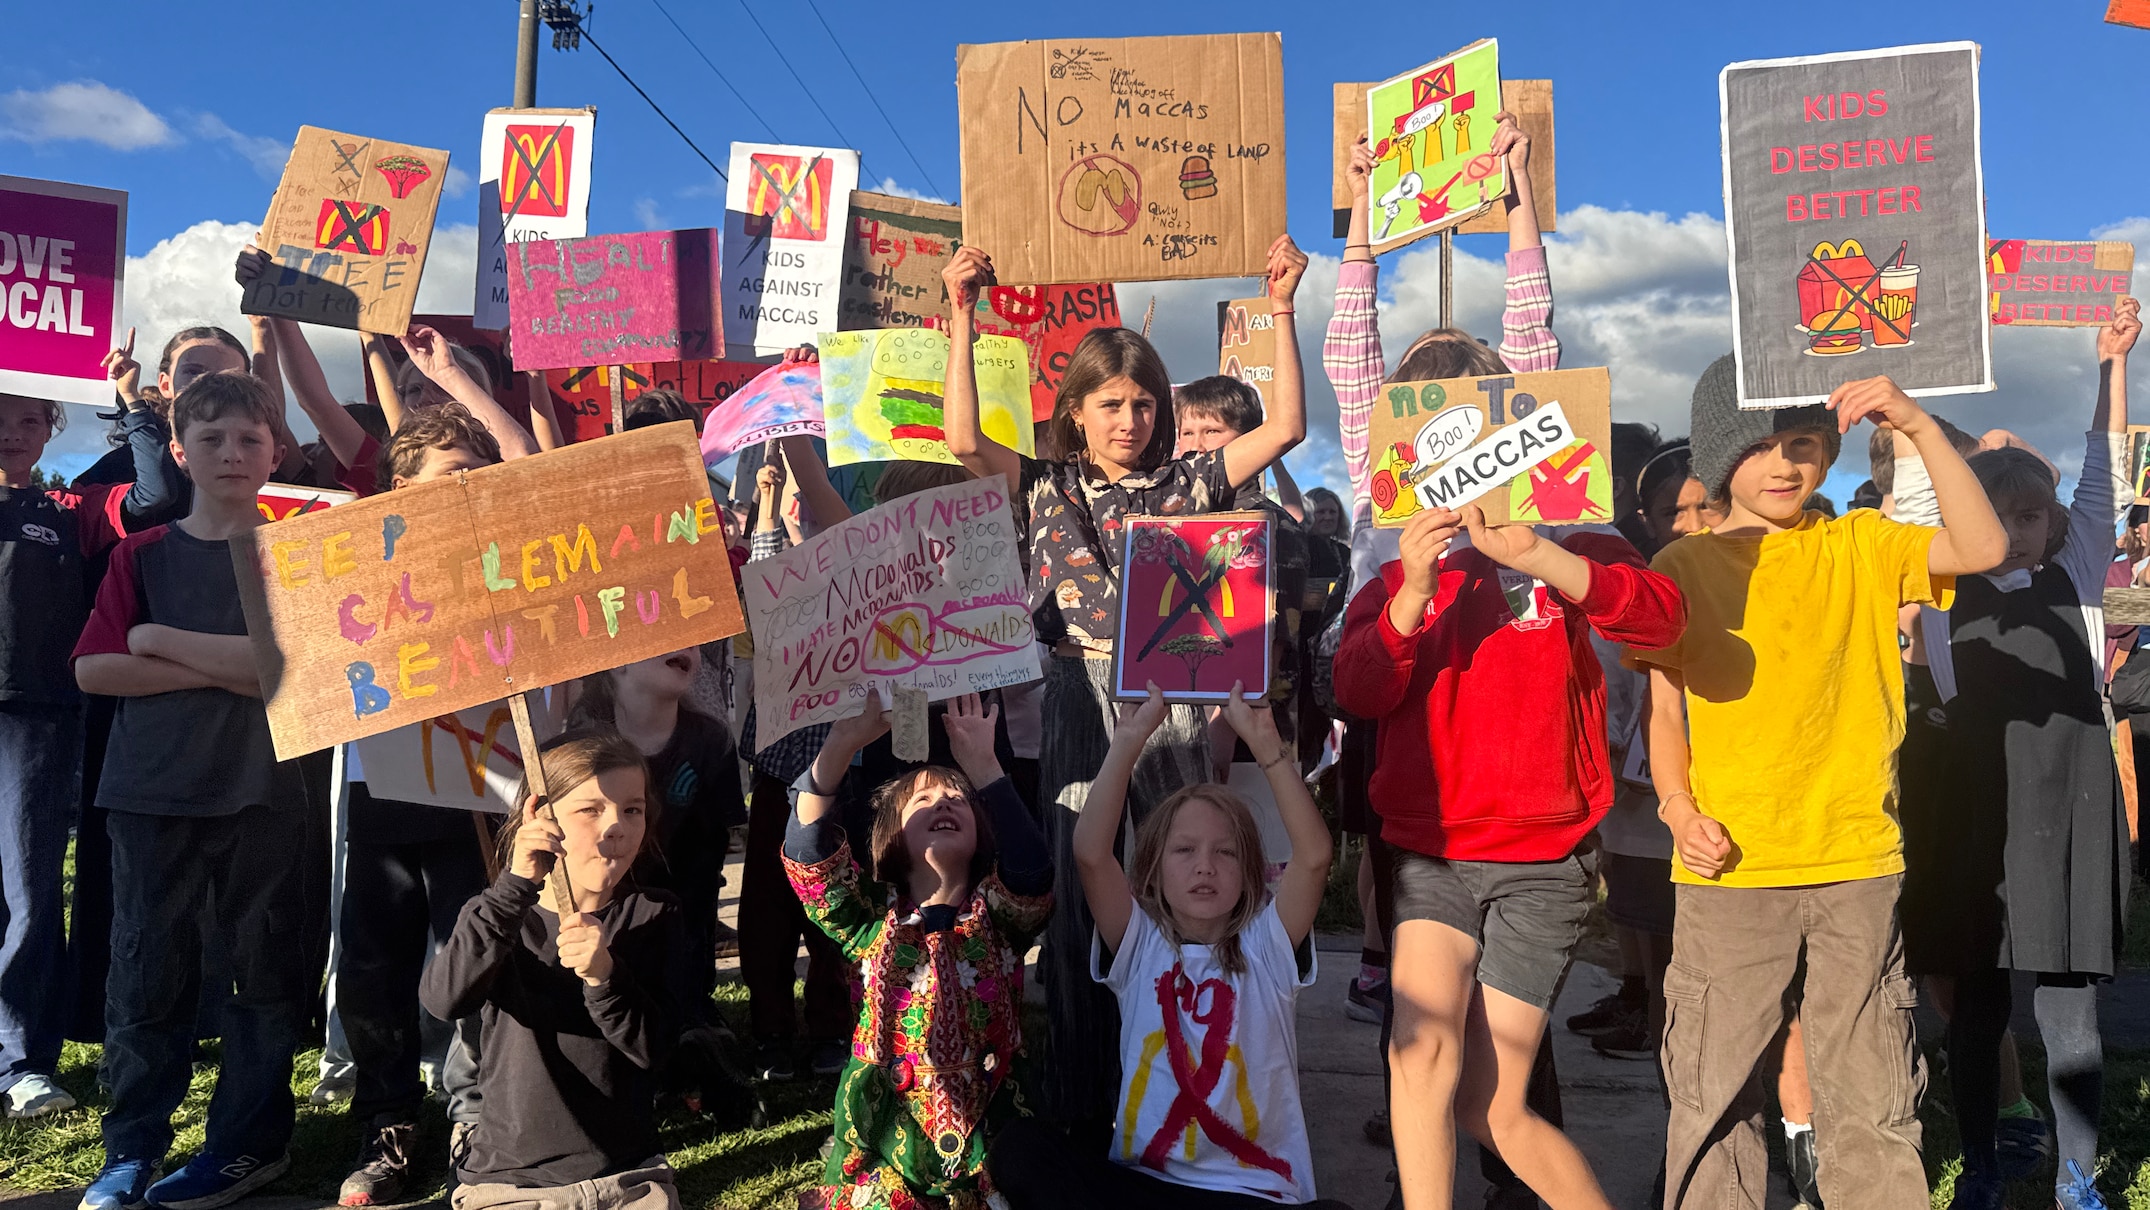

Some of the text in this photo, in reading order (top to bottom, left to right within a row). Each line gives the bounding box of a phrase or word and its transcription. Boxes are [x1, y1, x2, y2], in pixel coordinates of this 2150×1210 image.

[1018, 86, 1083, 154] NO
[1804, 89, 1888, 123] KIDS
[1227, 144, 1270, 166] LAND
[1770, 134, 1935, 175] DESERVE
[1786, 185, 1922, 222] BETTER
[762, 250, 805, 268] KIDS
[2025, 245, 2094, 263] KIDS
[739, 277, 823, 297] AGAINST
[1993, 274, 2129, 293] DESERVE
[739, 305, 818, 325] MACCAS
[2001, 303, 2112, 321] BETTER
[1423, 415, 1563, 508] MACCAS
[761, 540, 837, 599] WE
[928, 490, 1003, 531] NEED
[344, 567, 715, 720] BEAUTIFUL
